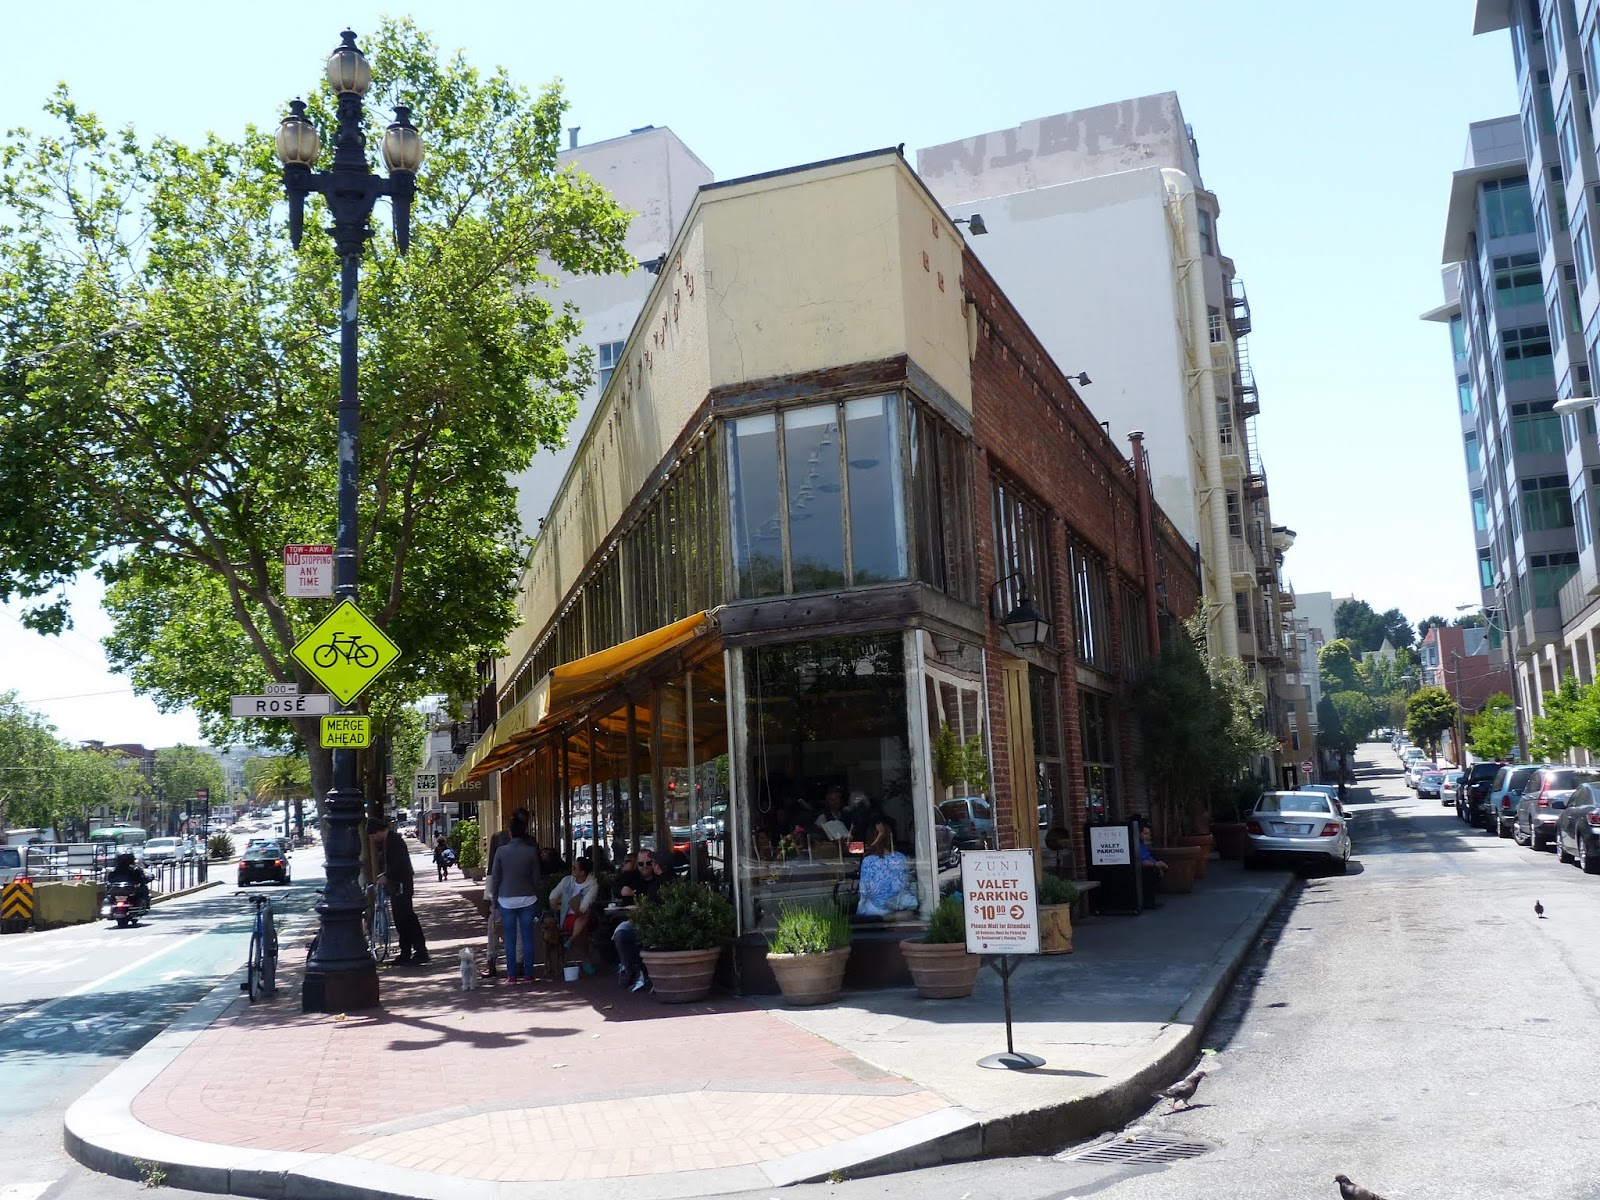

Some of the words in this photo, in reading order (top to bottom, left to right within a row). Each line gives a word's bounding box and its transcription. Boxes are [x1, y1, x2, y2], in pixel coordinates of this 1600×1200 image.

[286, 553, 299, 565] NO
[301, 555, 331, 565] STOPPING
[300, 567, 318, 576] ANY
[299, 577, 319, 586] TIME
[327, 720, 364, 731] MERGE
[326, 733, 365, 744] AHEAD
[974, 861, 1019, 872] ZUNI
[976, 879, 1018, 888] VALET
[969, 891, 1029, 901] PARKING
